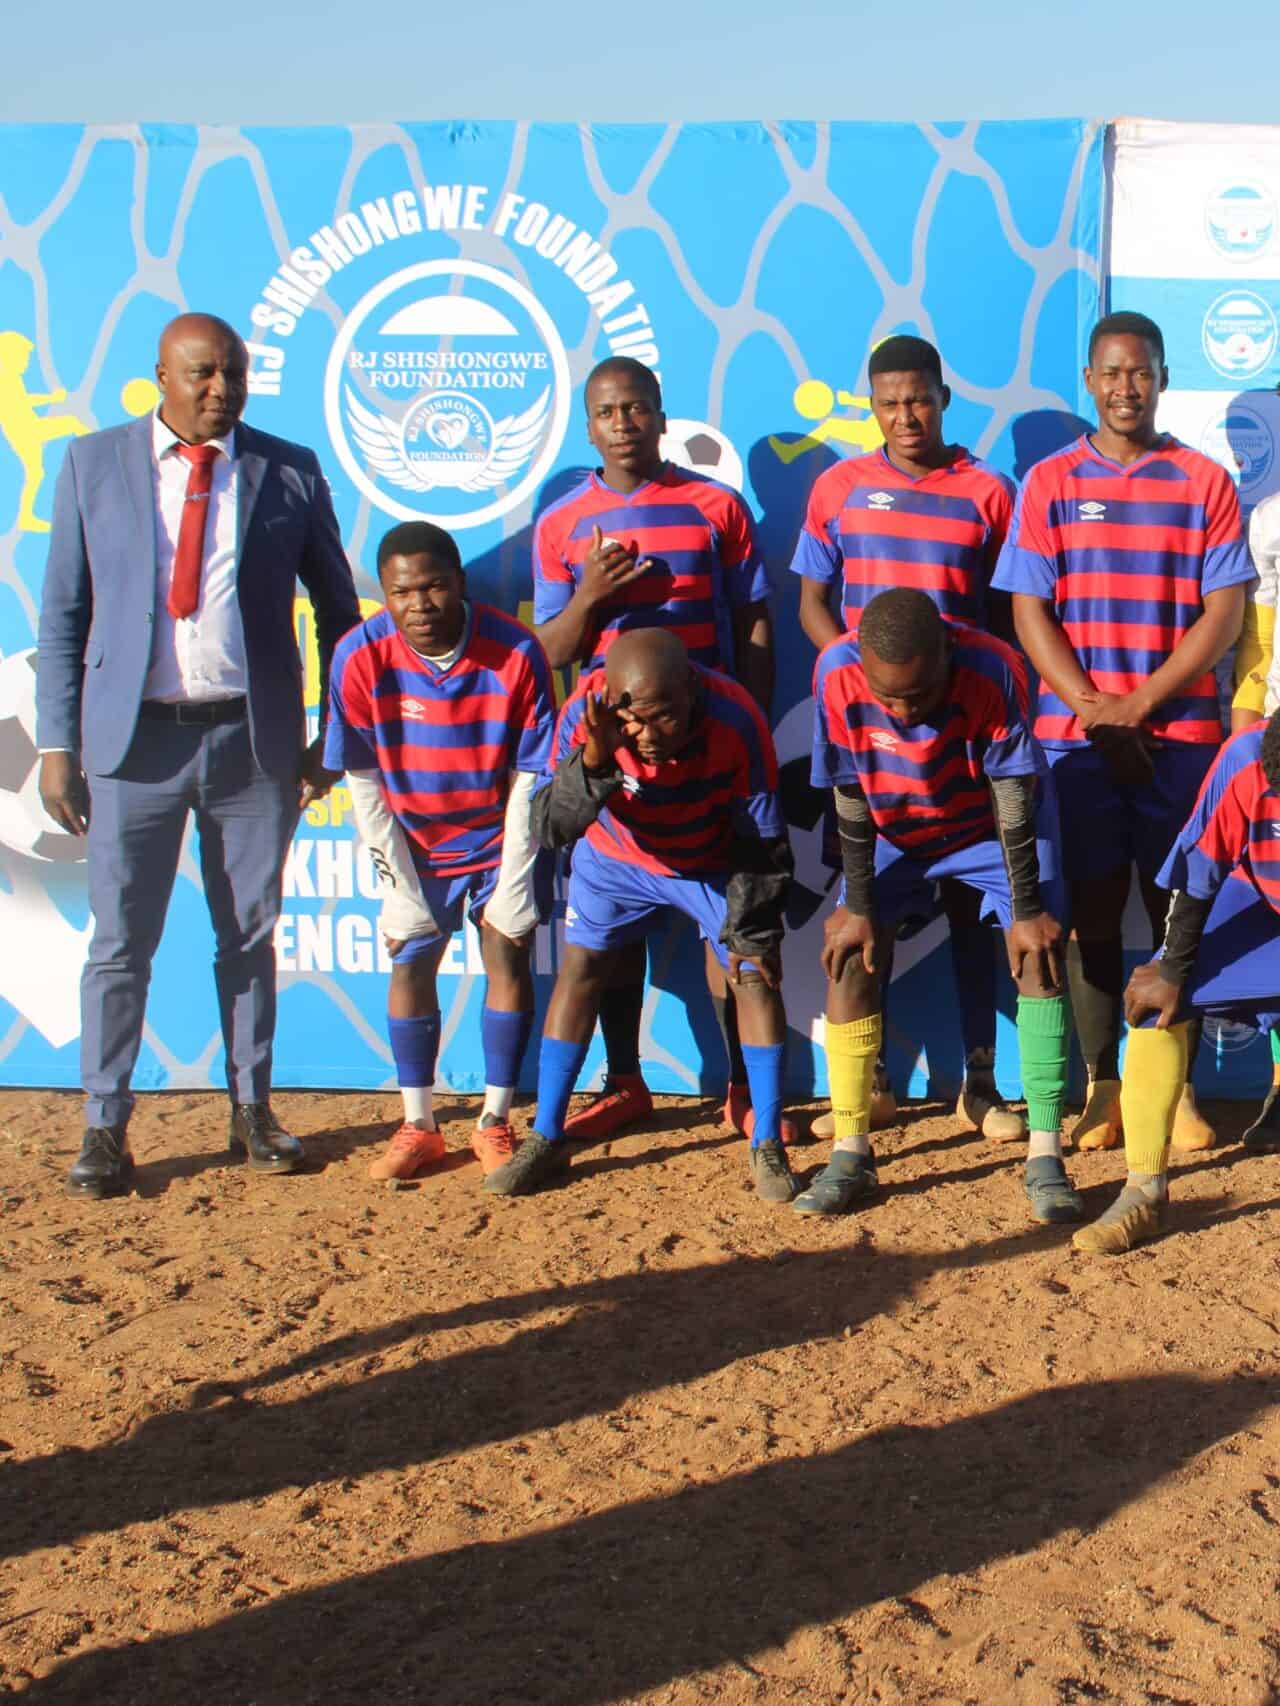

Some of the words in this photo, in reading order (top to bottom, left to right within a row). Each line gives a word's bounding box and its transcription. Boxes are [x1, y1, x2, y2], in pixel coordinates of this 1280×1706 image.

[250, 185, 490, 337] SHISHONGWE
[351, 352, 377, 368] RJ
[383, 352, 548, 369] SHISHONGWE
[370, 371, 526, 388] FOUNDATION
